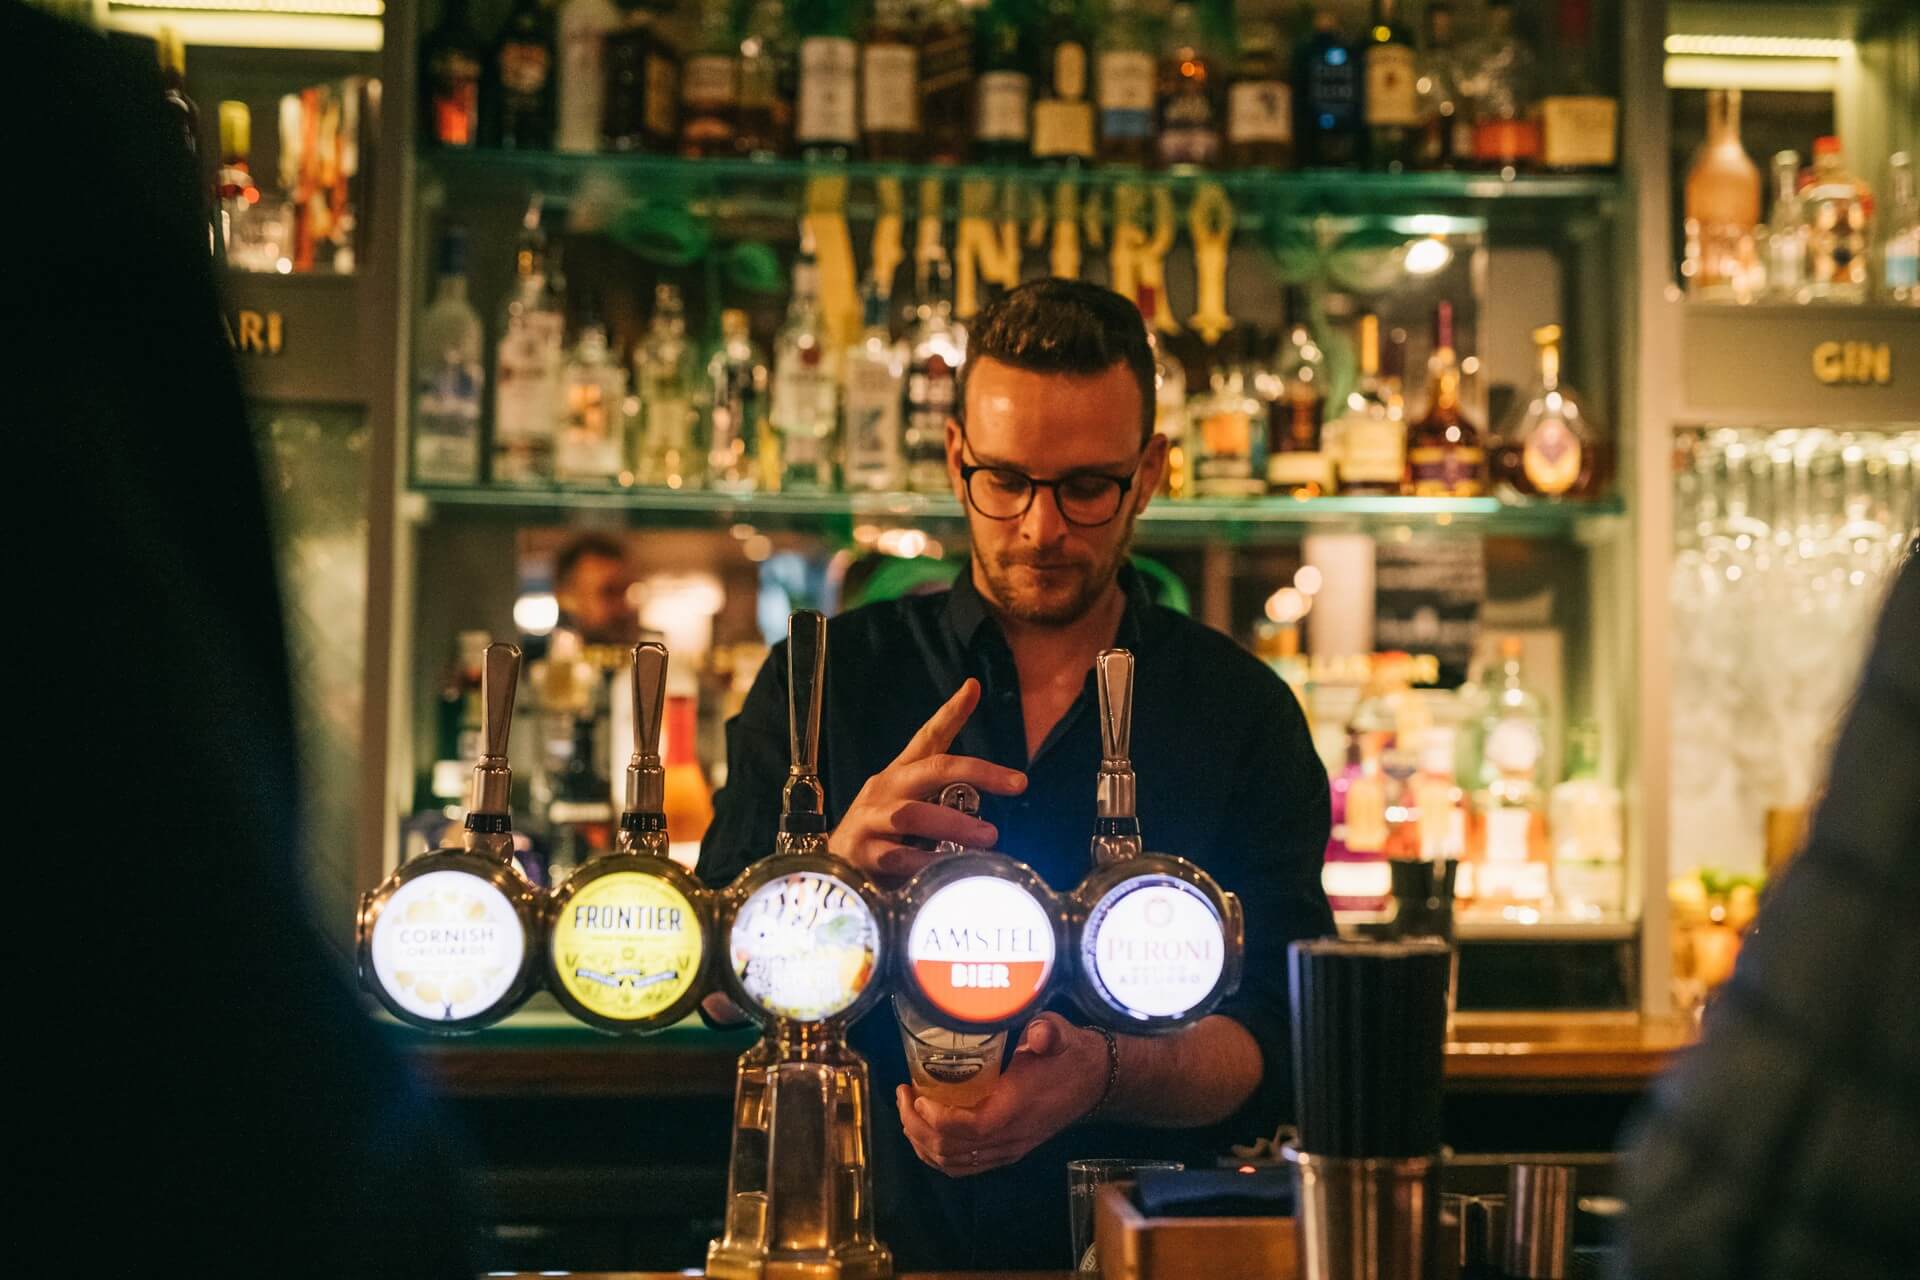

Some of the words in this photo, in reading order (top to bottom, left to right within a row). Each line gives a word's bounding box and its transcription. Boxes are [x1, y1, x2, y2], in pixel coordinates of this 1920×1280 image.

[1813, 341, 1890, 384] GIN
[574, 904, 682, 931] FRONTIER
[399, 927, 495, 944] CORNISH
[923, 928, 1040, 952] AMSTEL
[1107, 938, 1213, 961] PERONI
[951, 963, 1010, 988] BIER
